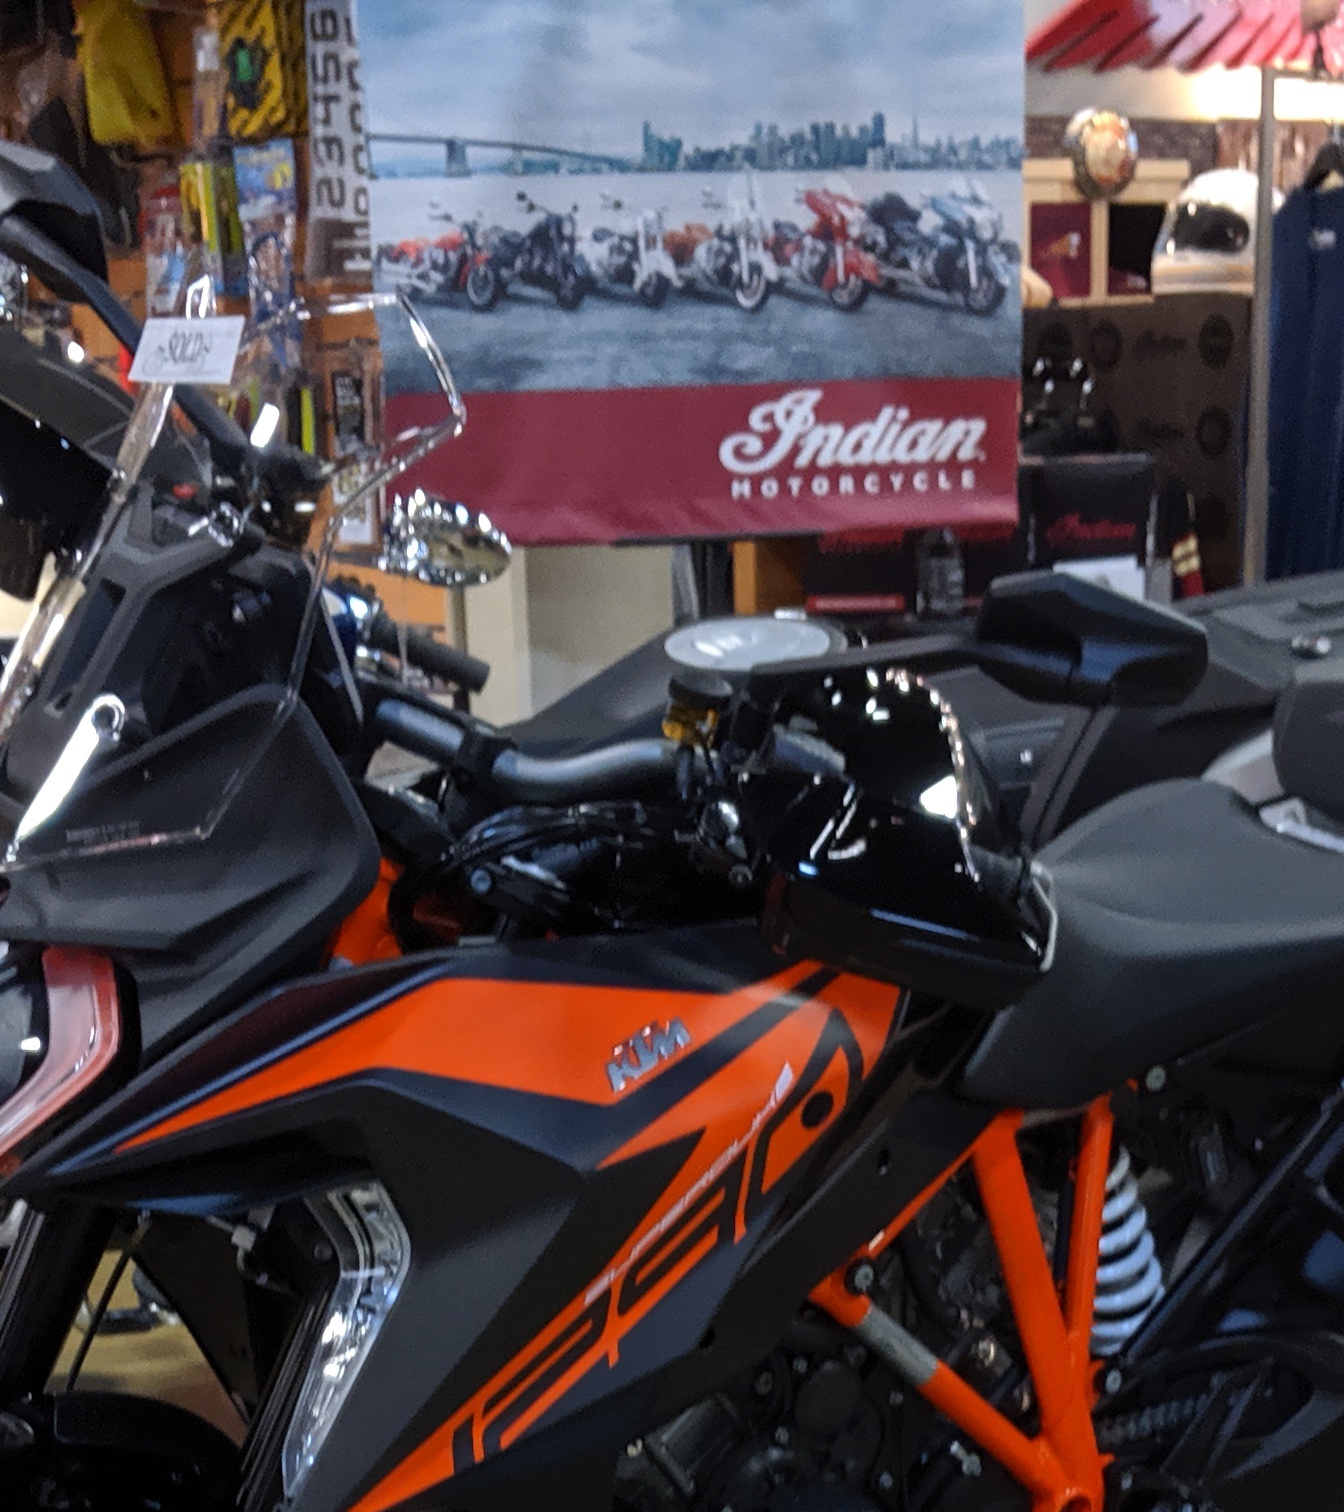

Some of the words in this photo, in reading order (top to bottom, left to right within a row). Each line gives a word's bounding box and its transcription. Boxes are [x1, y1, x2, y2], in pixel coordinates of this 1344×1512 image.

[718, 388, 987, 474] Indian
[730, 468, 975, 499] MOTORCYCLE
[606, 1016, 691, 1093] KTM
